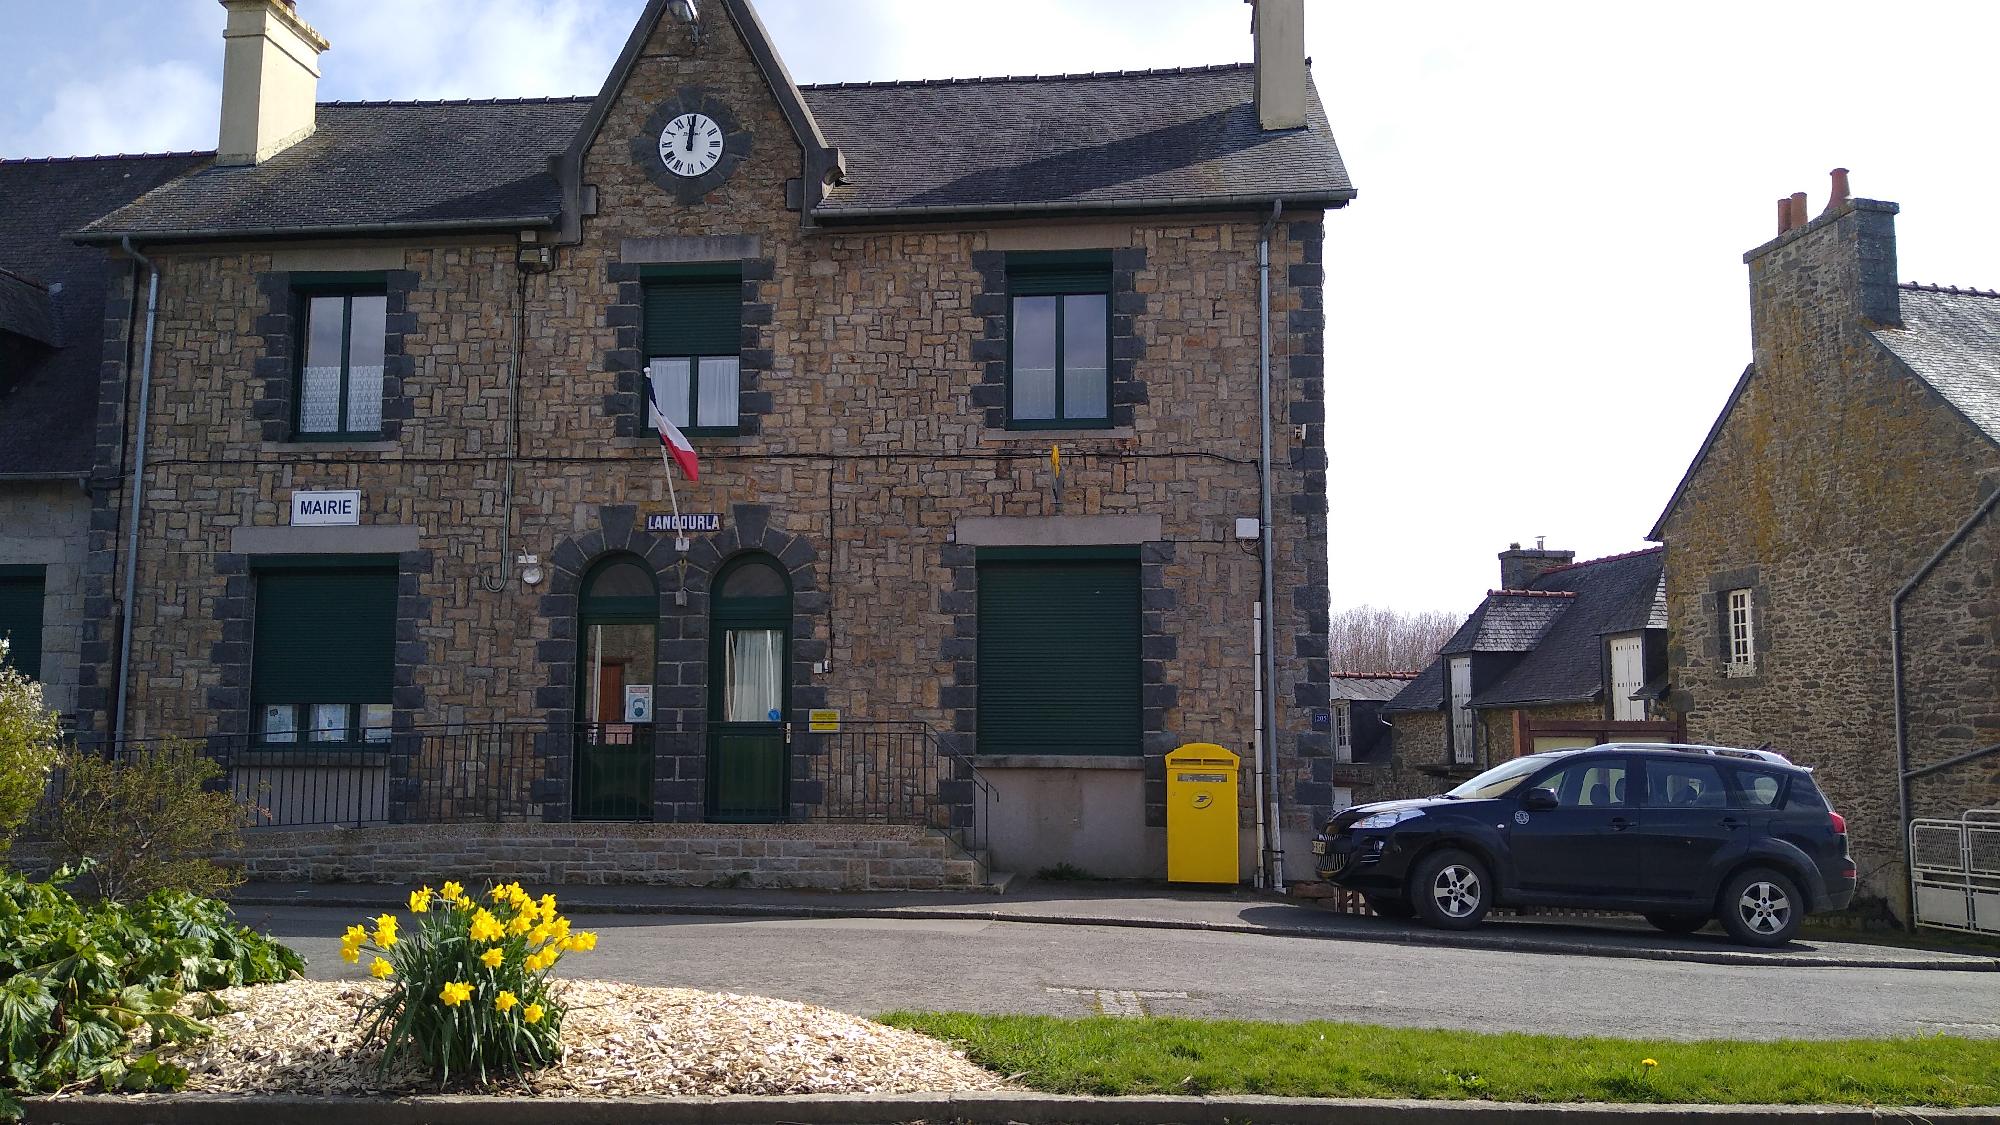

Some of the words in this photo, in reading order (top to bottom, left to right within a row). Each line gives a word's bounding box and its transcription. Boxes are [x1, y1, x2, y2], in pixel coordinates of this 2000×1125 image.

[700, 119, 708, 129] I
[664, 129, 676, 138] X
[707, 128, 718, 137] II
[699, 160, 708, 170] V
[300, 500, 352, 515] MAIRIE
[648, 515, 720, 530] LANGOURLA
